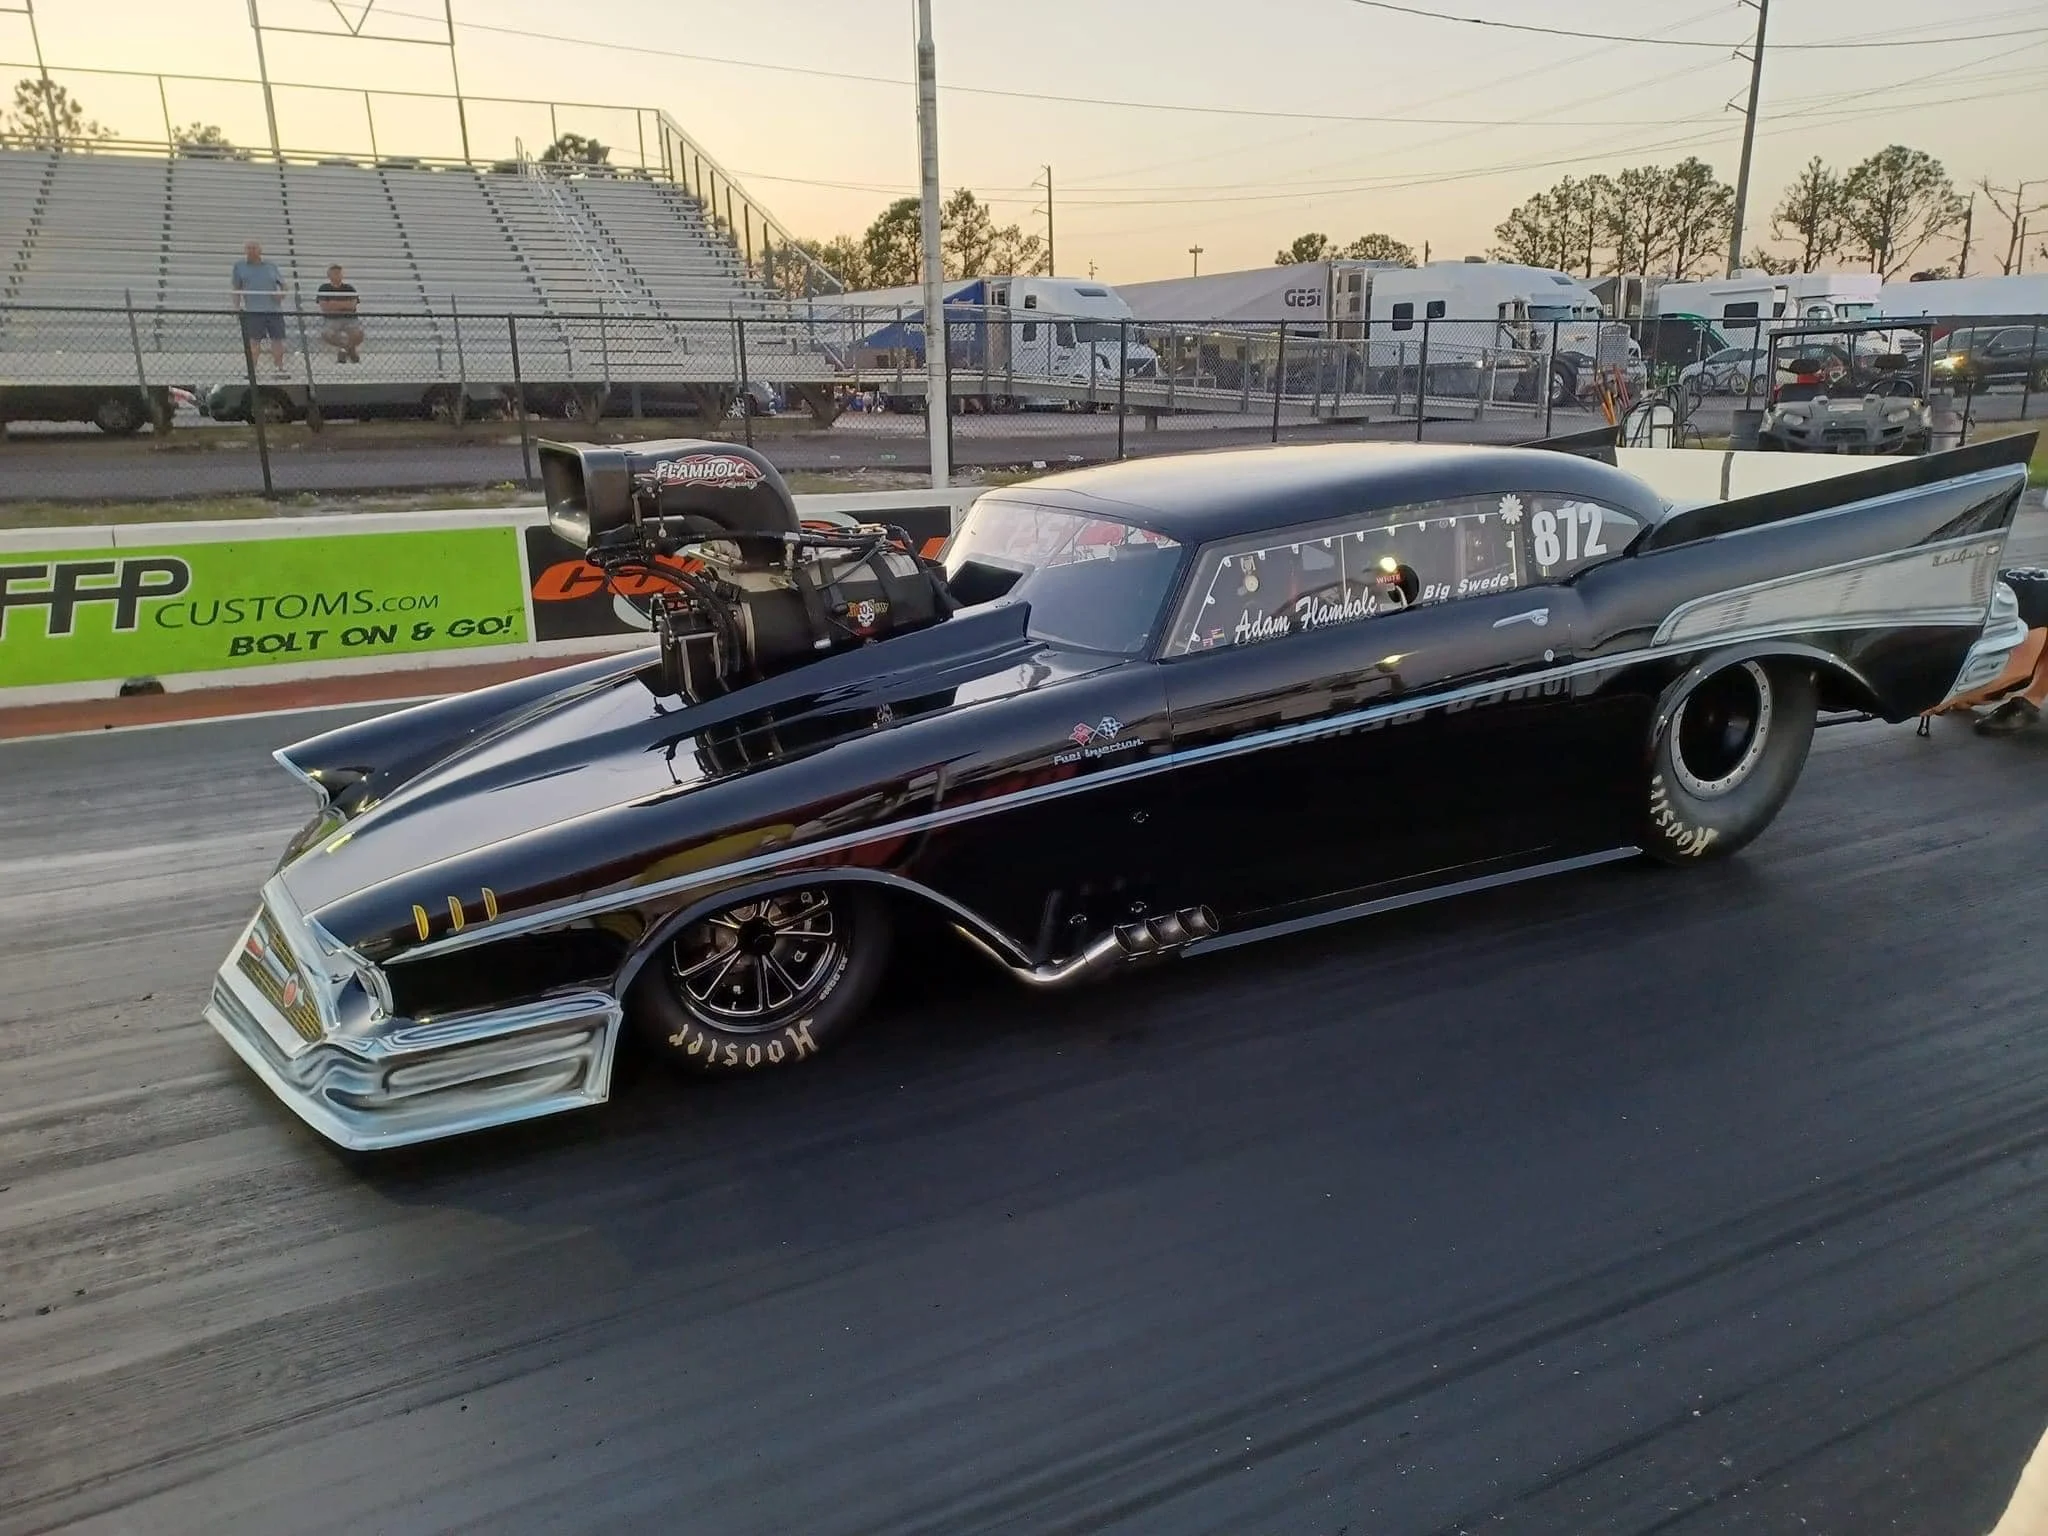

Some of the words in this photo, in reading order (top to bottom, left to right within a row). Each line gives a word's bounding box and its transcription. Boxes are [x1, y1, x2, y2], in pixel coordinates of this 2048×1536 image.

[1531, 502, 1607, 566] 872
[1423, 582, 1450, 600] Big
[1457, 573, 1509, 593] Swede
[229, 631, 329, 657] BOLT
[340, 625, 398, 648] ON
[410, 622, 436, 641] &
[445, 615, 514, 639] GO!
[1234, 609, 1291, 644] Adam
[1053, 751, 1082, 766] Fuel
